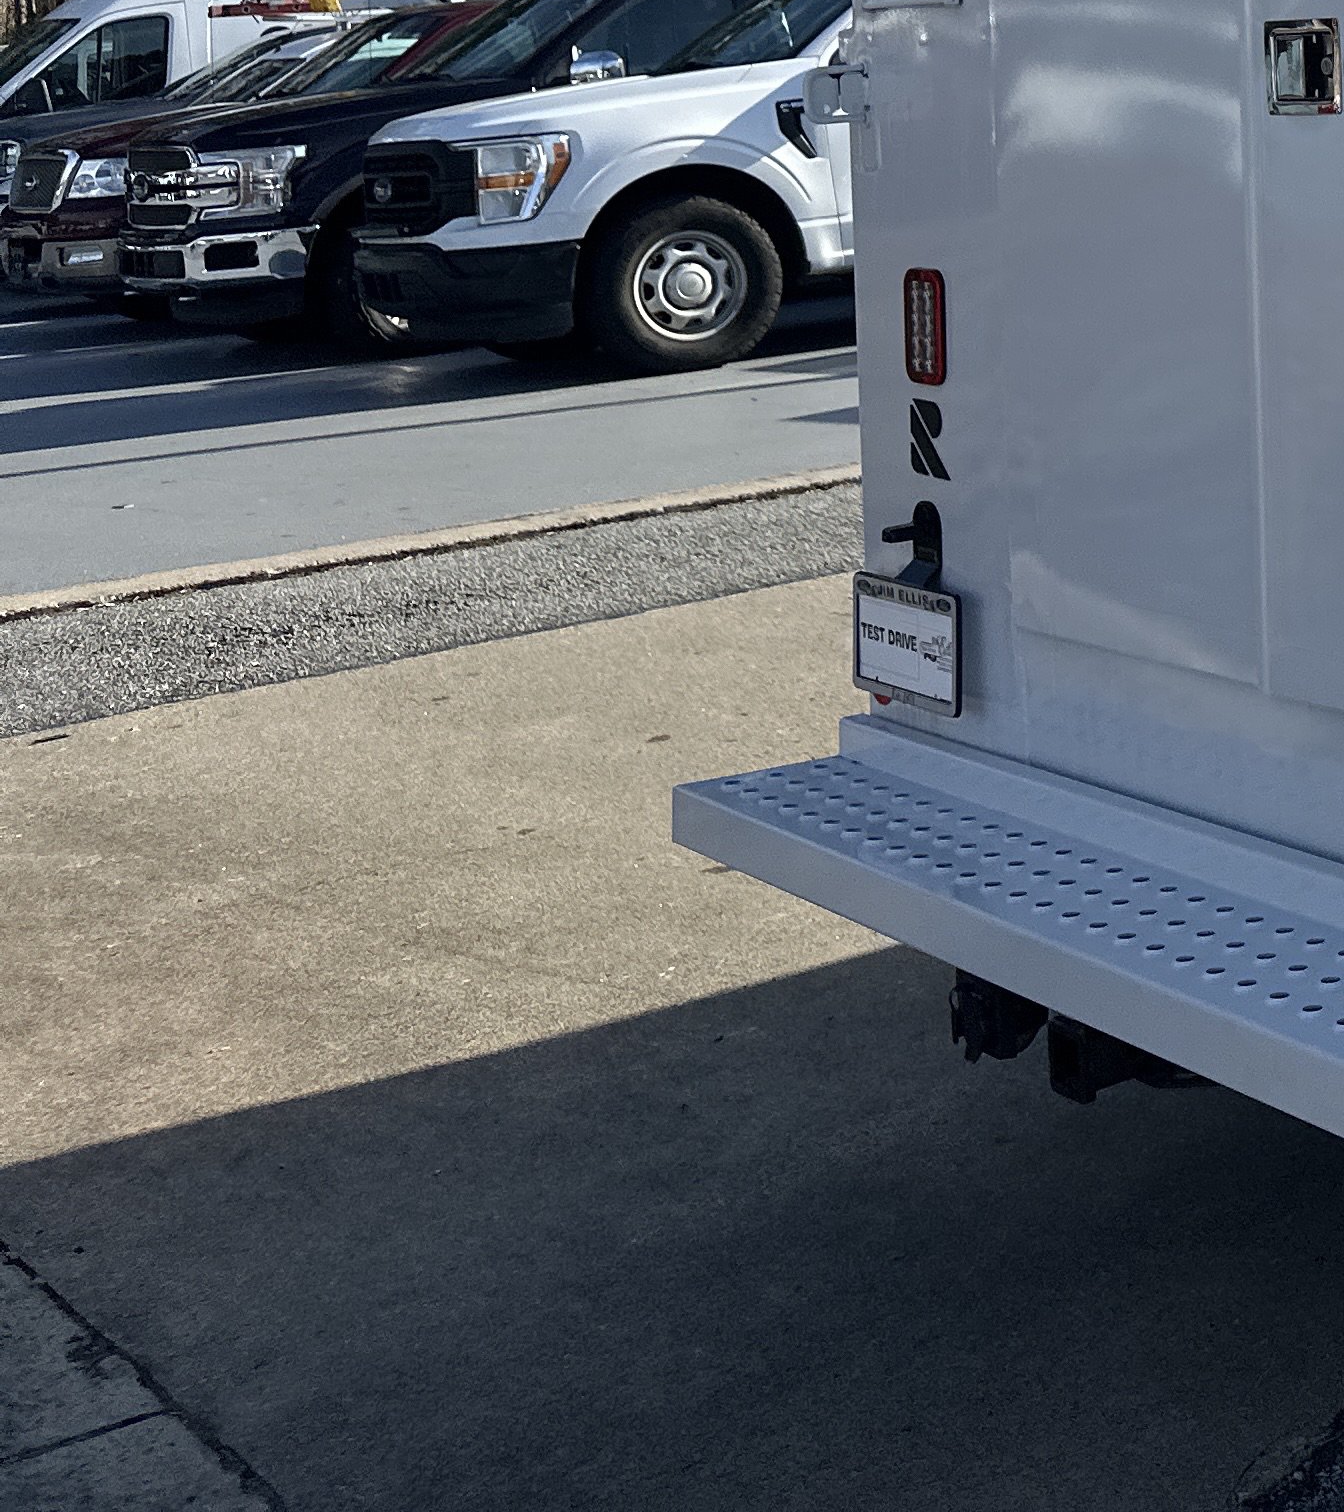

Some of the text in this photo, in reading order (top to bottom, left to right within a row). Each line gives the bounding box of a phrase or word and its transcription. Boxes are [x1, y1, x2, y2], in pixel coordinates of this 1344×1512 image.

[898, 589, 928, 606] ELLIS
[861, 621, 917, 652] TEST DRIVE
